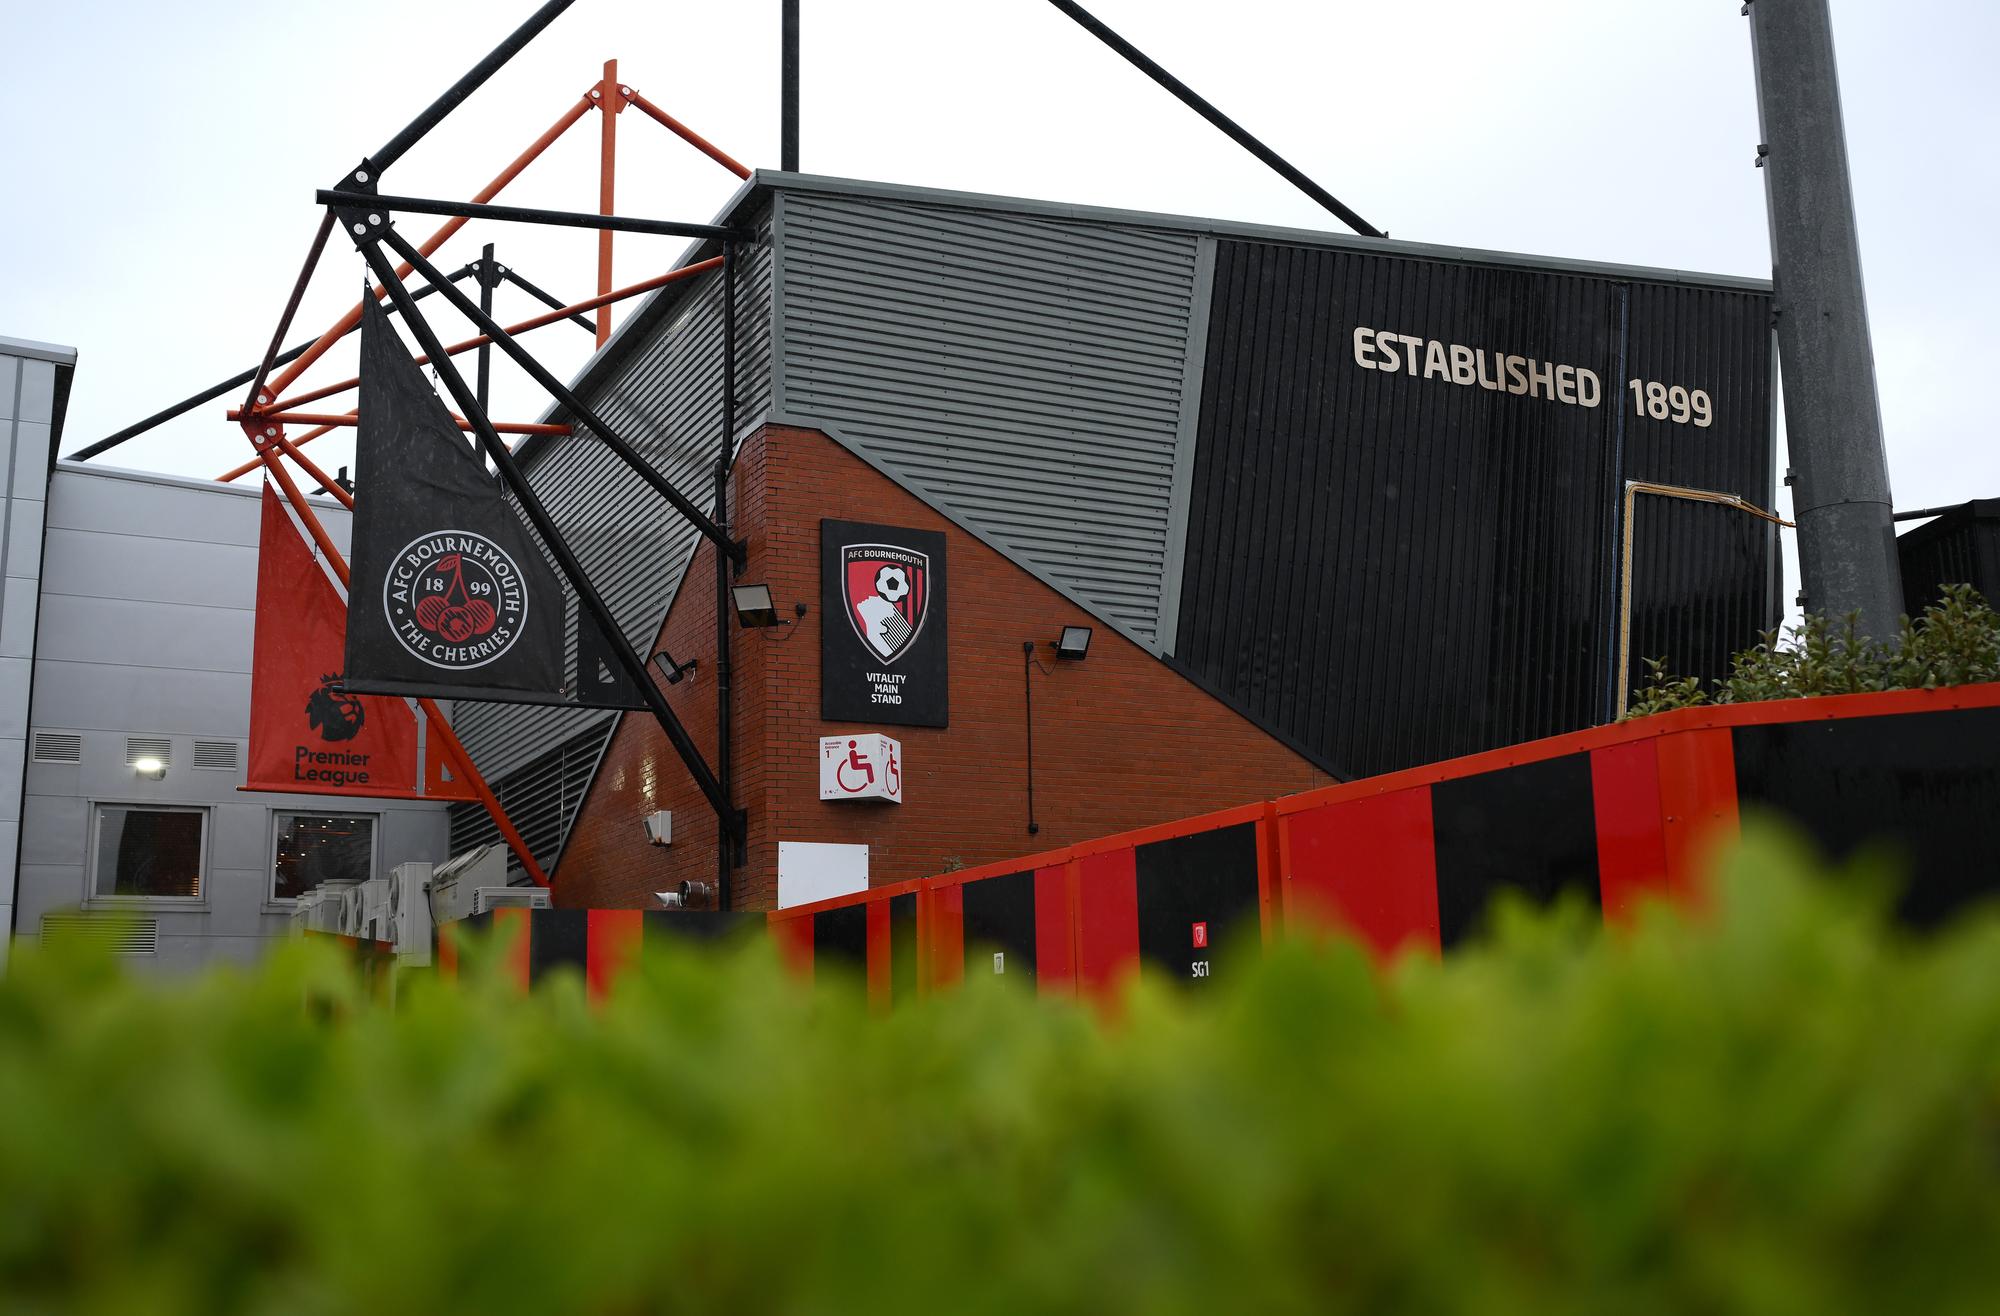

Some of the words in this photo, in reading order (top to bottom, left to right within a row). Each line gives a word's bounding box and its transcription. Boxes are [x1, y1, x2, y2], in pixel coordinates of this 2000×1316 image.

[1353, 326, 1600, 408] ESTABLISHED
[1629, 378, 1713, 428] 1899
[848, 550, 863, 559] AFC
[864, 550, 923, 567] BOURNEMOUTH
[392, 566, 413, 603] AFC
[407, 537, 520, 612] BOURNEMOUTH
[425, 578, 444, 592] 18
[470, 582, 491, 596] 99
[401, 619, 431, 651] THE
[432, 626, 510, 662] CHERRIES
[866, 672, 906, 684] VITALITY
[874, 684, 899, 694] MAIN
[871, 694, 902, 705] STAND
[295, 746, 370, 766] Premier
[826, 750, 830, 758] 1
[294, 764, 370, 786] League
[1191, 960, 1209, 978] SG1
